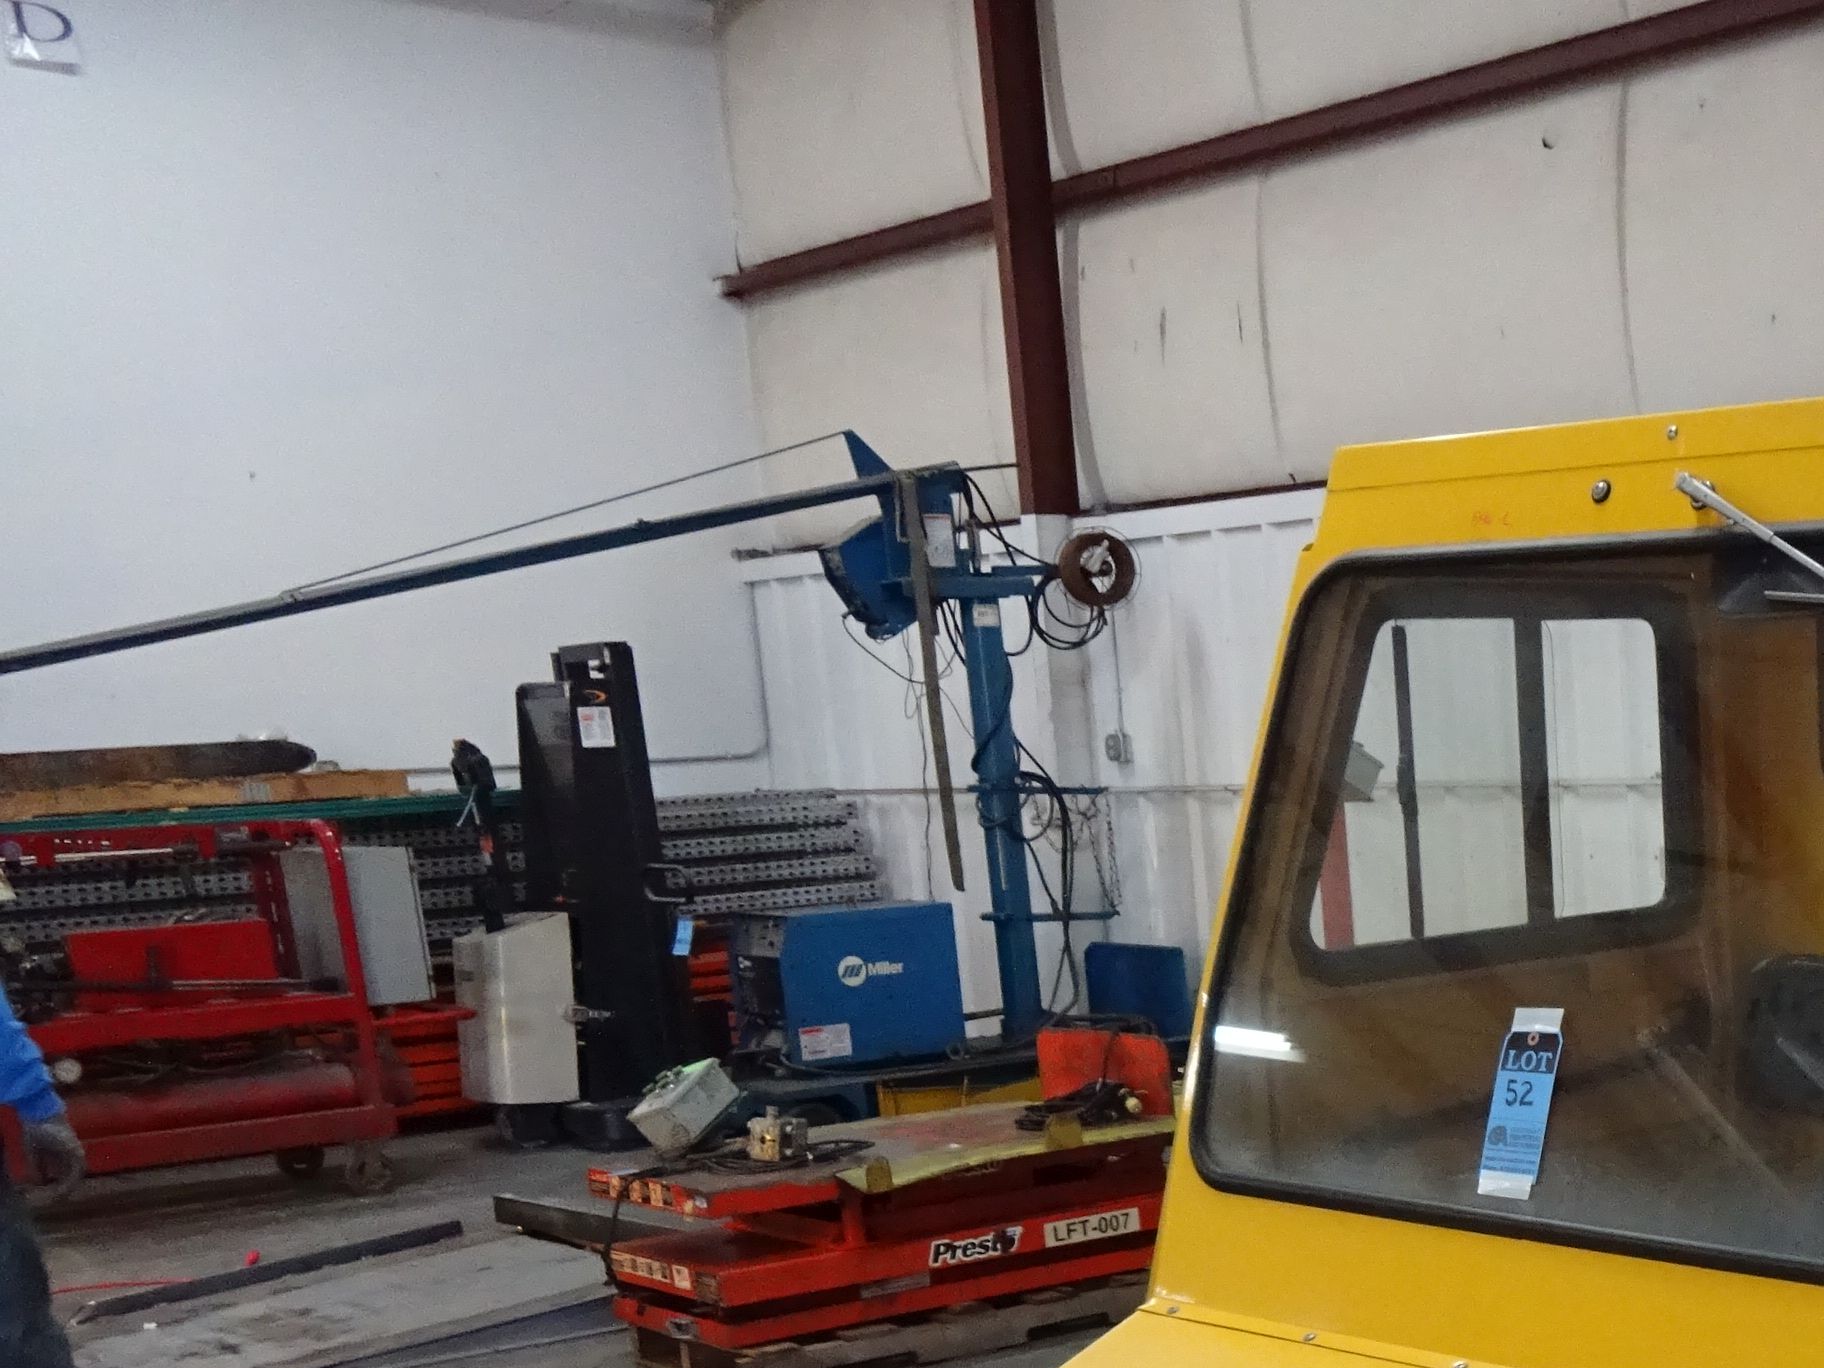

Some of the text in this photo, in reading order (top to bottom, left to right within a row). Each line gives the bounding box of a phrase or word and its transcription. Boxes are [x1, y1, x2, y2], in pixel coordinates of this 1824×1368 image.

[9, 0, 73, 42] D
[868, 961, 904, 976] Miller
[1506, 1050, 1553, 1072] LOT
[1505, 1079, 1534, 1107] 52
[1053, 1213, 1130, 1242] LFT-007
